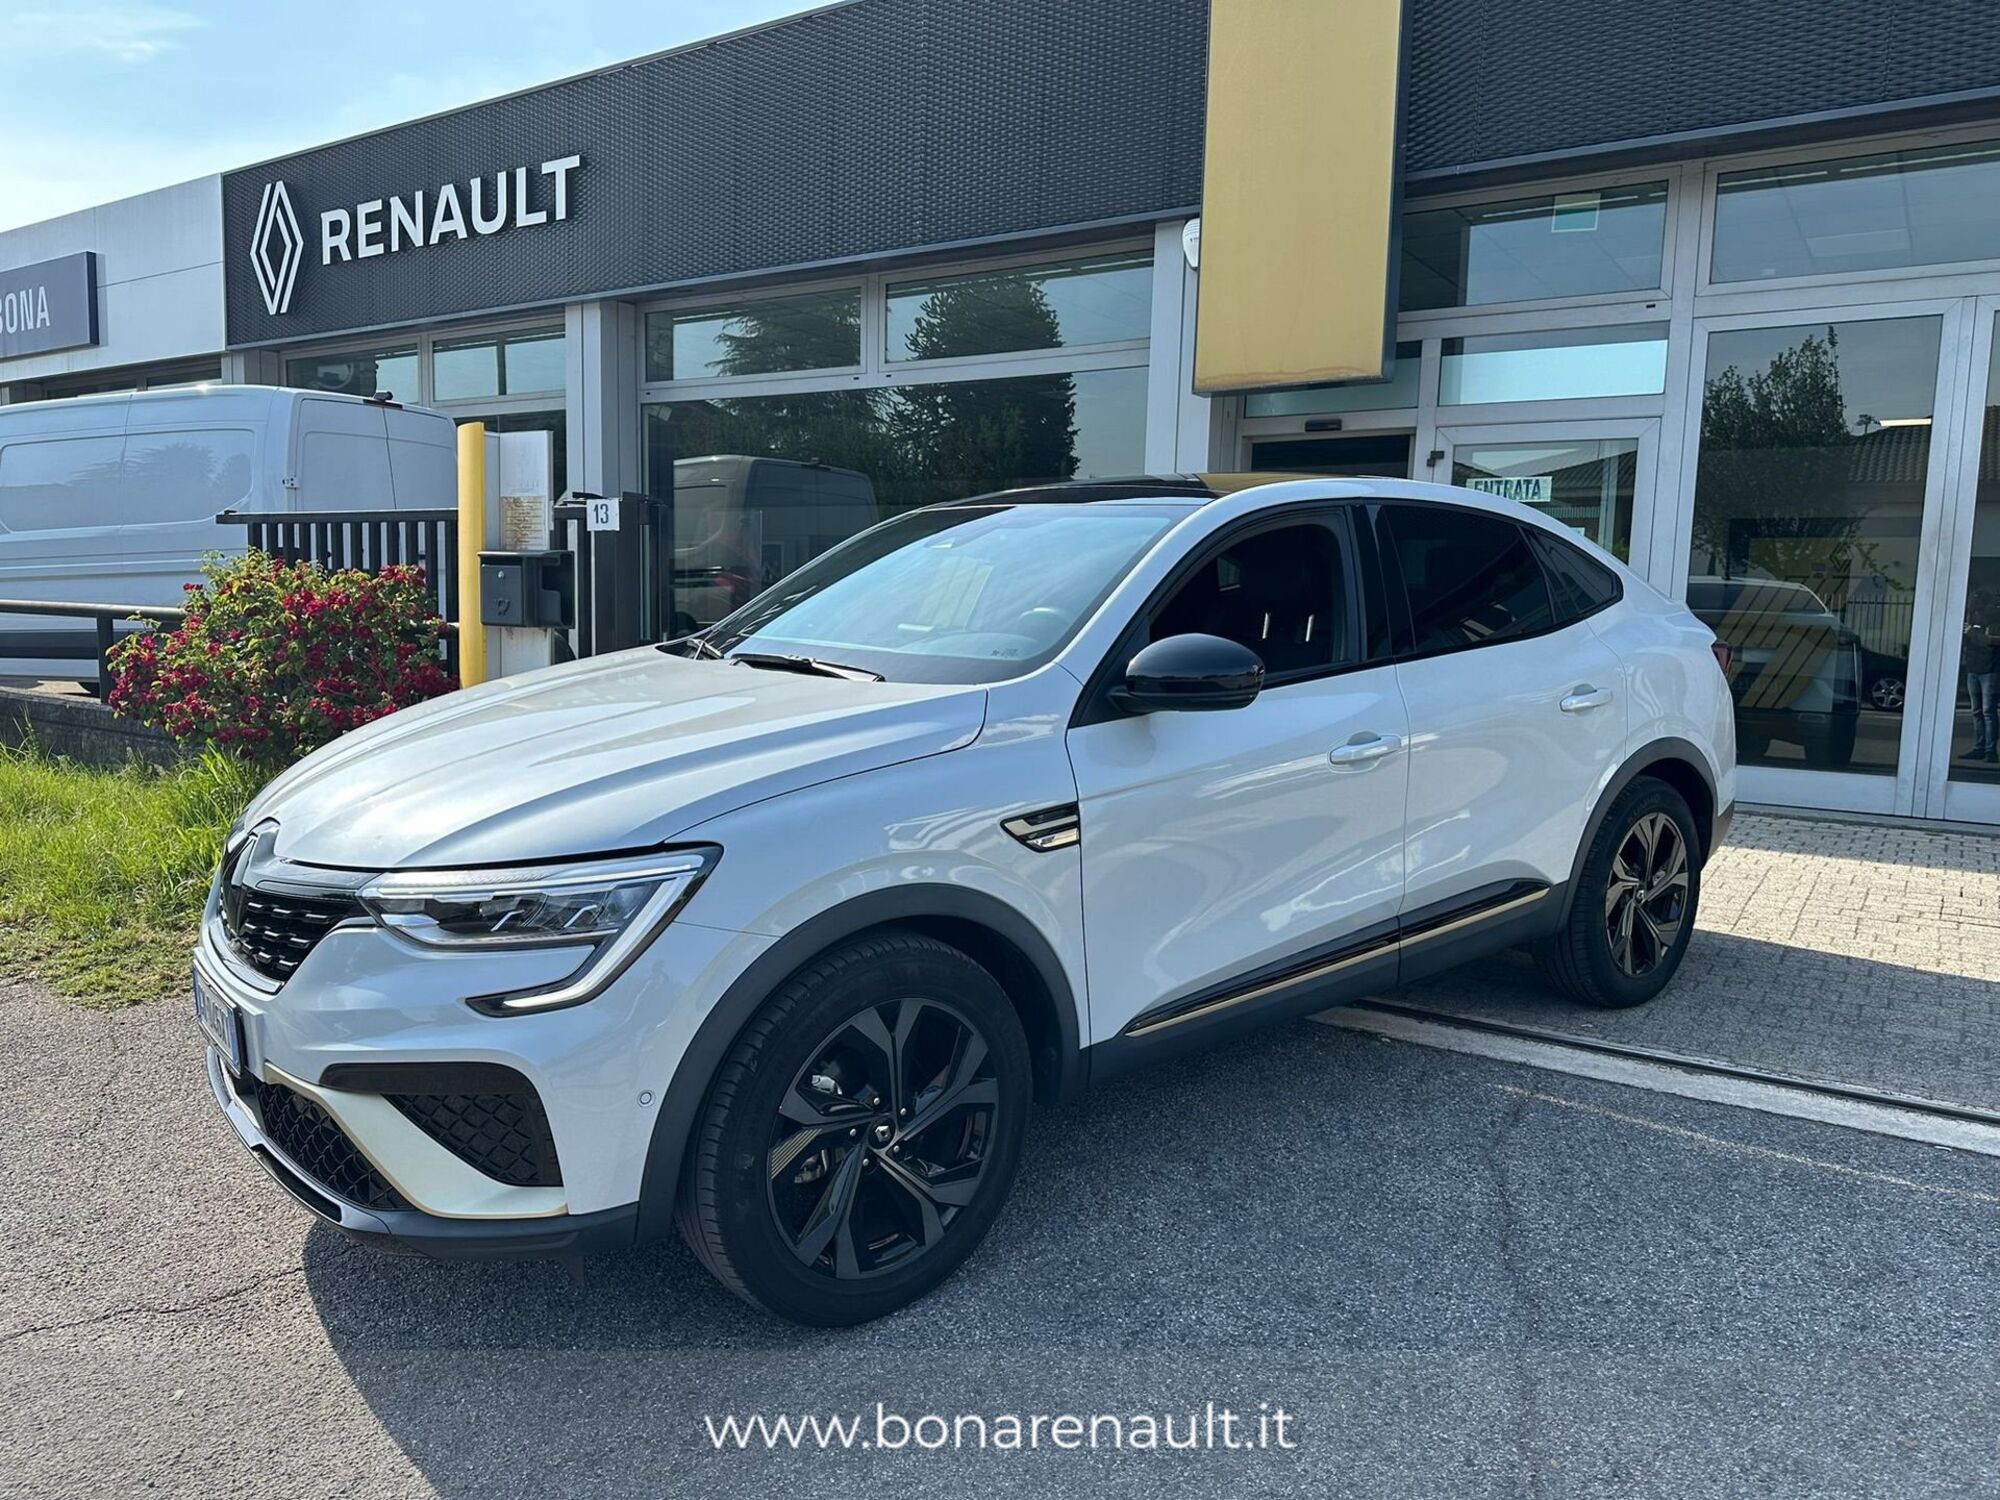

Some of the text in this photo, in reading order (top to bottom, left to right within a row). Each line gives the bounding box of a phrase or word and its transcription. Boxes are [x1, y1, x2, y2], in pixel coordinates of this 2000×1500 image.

[320, 154, 580, 265] RENAULT
[0, 286, 51, 335] ONA
[593, 503, 609, 524] 13
